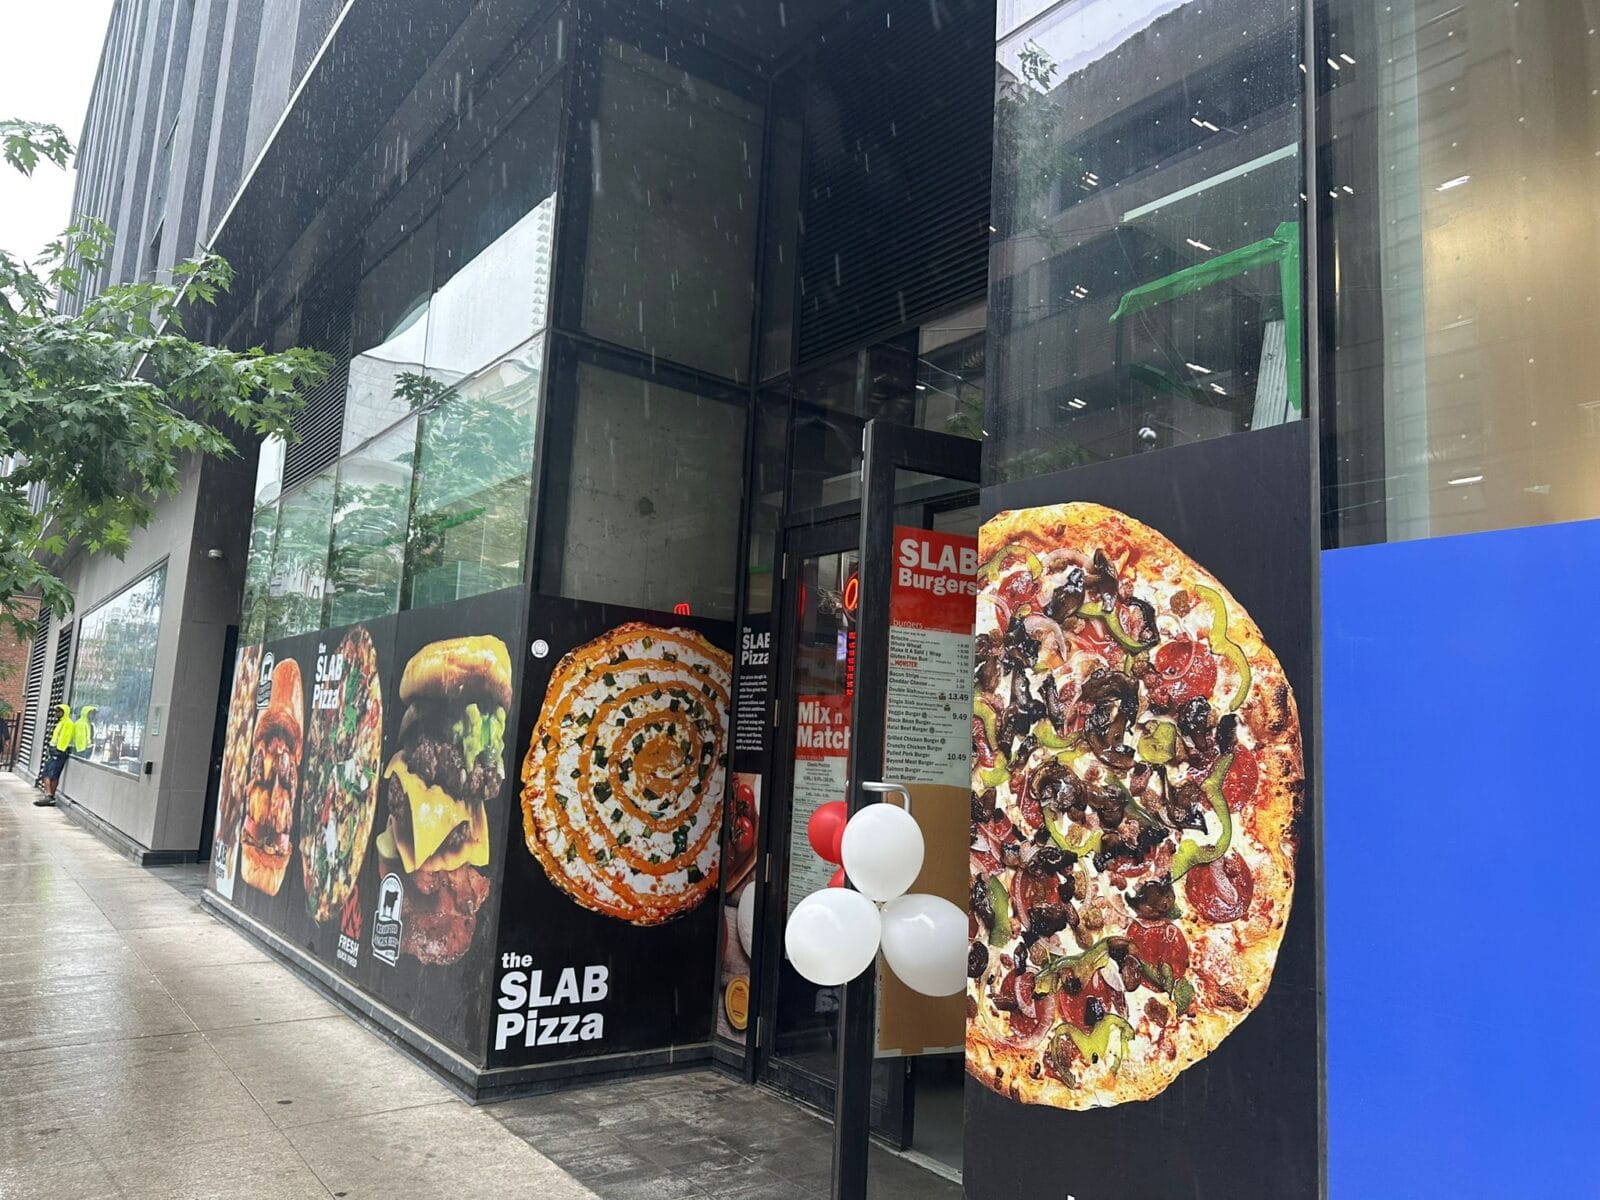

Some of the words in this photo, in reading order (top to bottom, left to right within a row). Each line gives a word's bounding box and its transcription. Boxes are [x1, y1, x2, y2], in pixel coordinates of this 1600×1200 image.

[899, 538, 978, 576] SLAB
[898, 567, 977, 596] Burgers
[316, 653, 344, 682] SLAB
[312, 682, 340, 709] Pizza
[949, 693, 968, 701] 13.49
[798, 702, 831, 724] Mix
[338, 934, 360, 957] FRESH
[502, 952, 533, 969] the
[498, 965, 609, 1010] SLAB
[495, 1010, 604, 1051] Pizza
